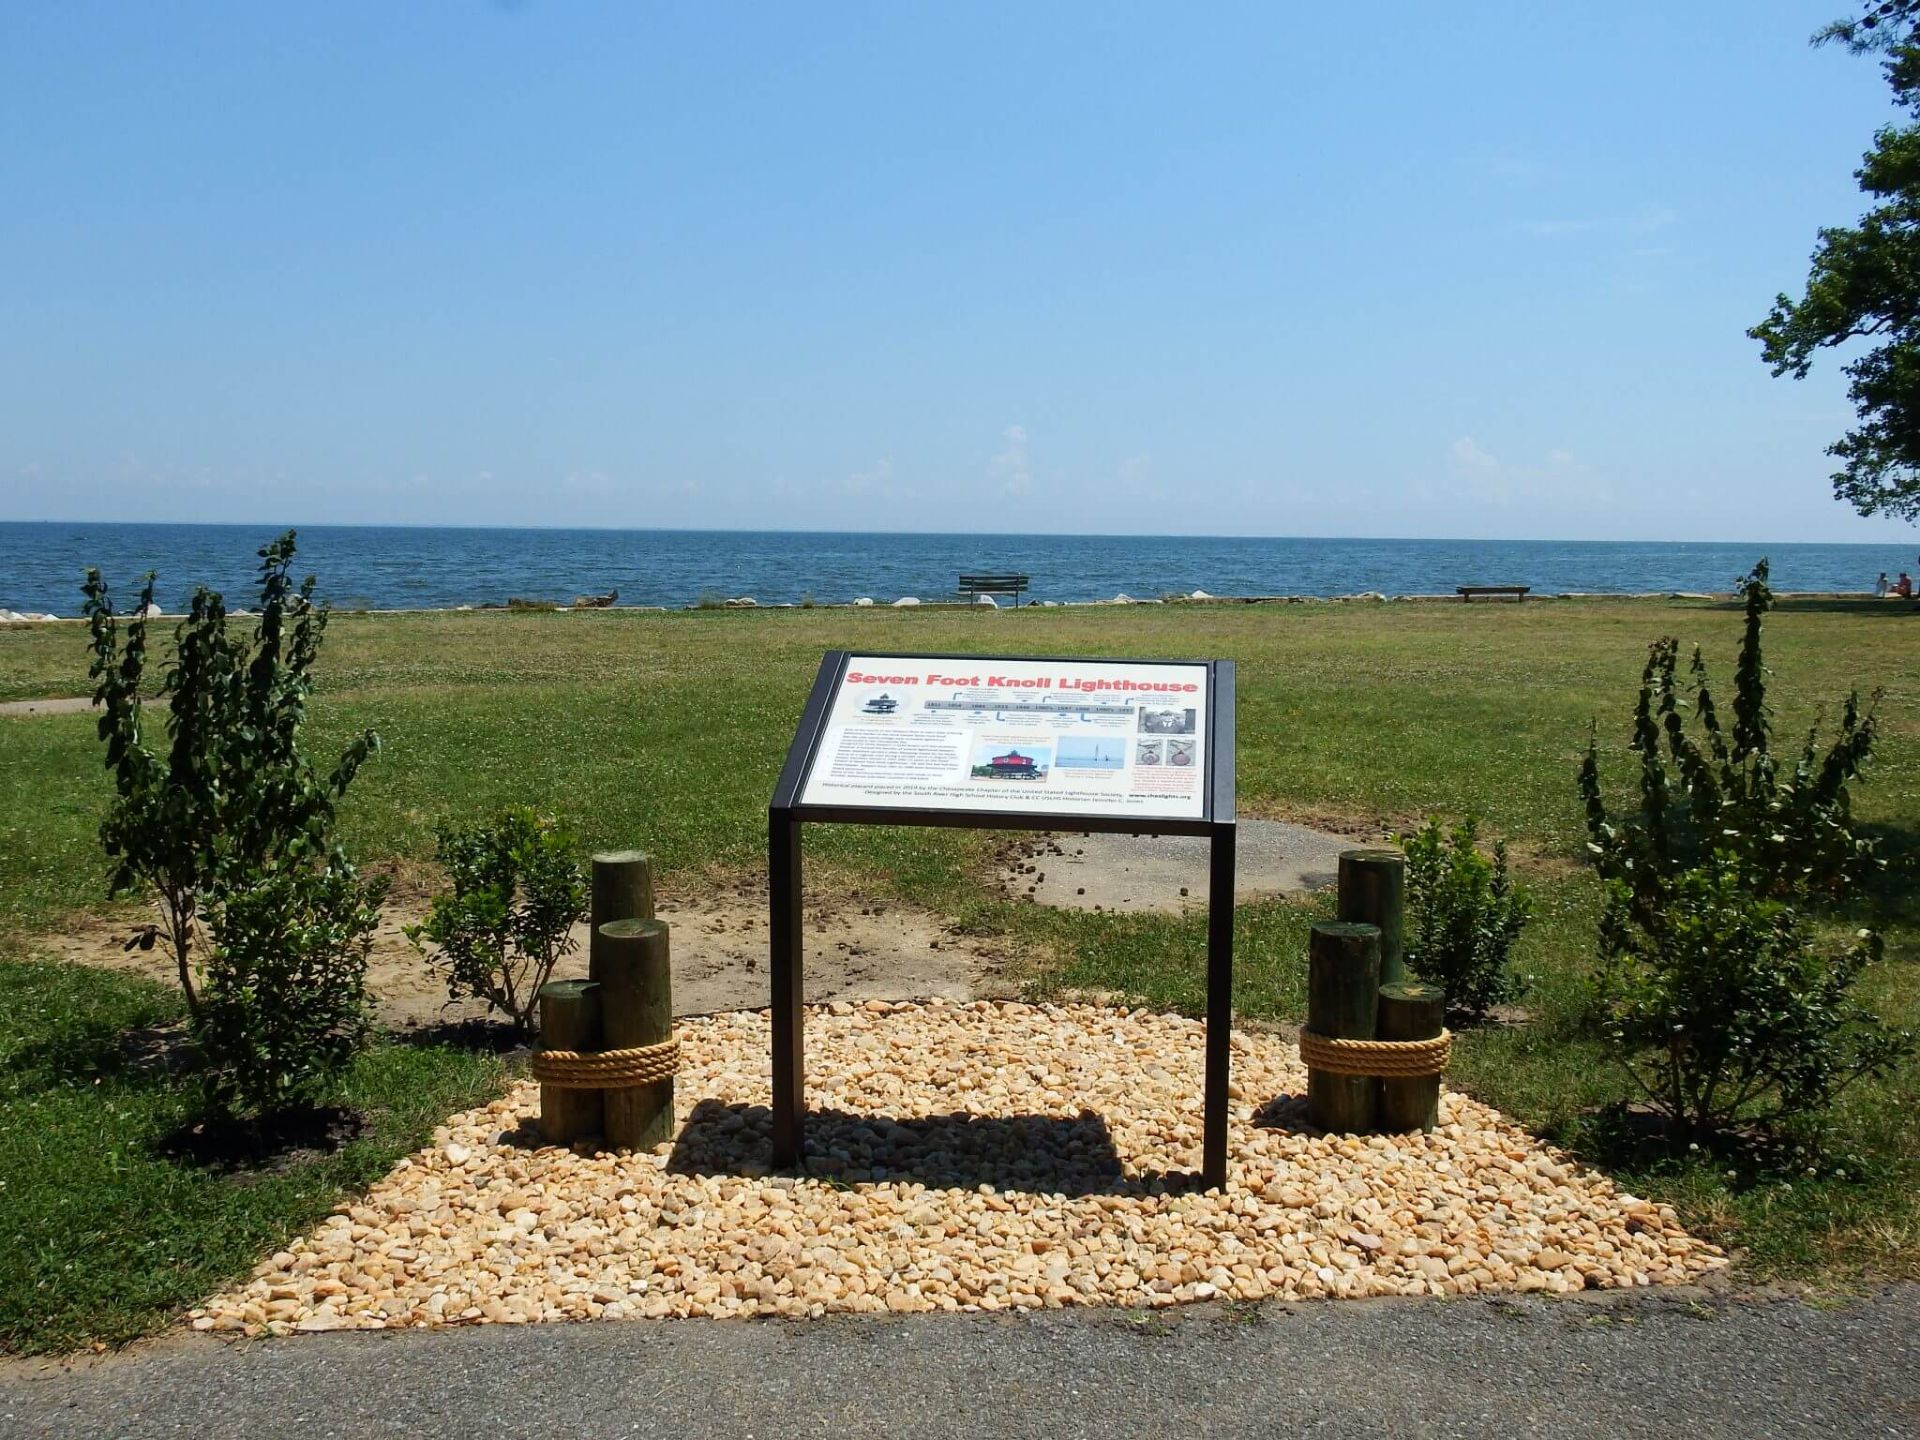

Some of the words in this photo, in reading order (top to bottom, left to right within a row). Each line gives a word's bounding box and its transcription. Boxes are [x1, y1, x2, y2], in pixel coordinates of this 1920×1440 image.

[846, 672, 919, 685] Seven
[926, 674, 981, 687] Foot
[987, 676, 1052, 689] Knoll
[1059, 678, 1199, 692] Lighthouse
